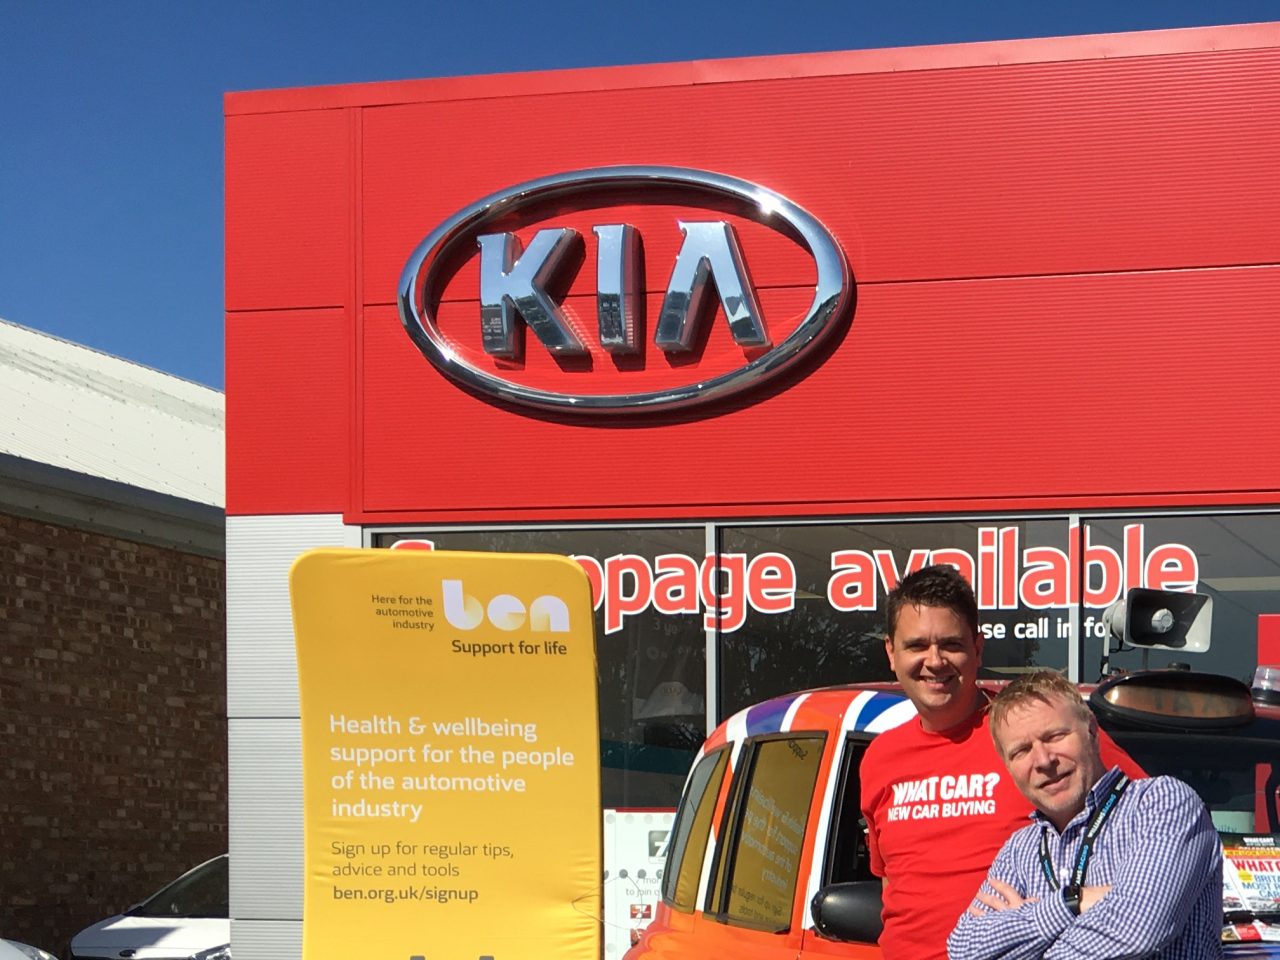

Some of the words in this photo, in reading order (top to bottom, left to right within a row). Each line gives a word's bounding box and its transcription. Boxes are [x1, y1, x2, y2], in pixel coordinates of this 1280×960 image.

[476, 221, 773, 354] KIA
[371, 594, 397, 605] Here
[398, 594, 414, 605] for
[415, 595, 433, 605] the
[442, 579, 570, 632] ben
[375, 606, 434, 618] automotive
[392, 619, 435, 632] industry
[1014, 617, 1049, 639] call
[451, 640, 515, 657] Support
[519, 640, 540, 655] for
[544, 641, 568, 655] life
[329, 715, 401, 735] Health
[408, 716, 426, 735] &
[432, 718, 537, 742] wellbeing
[330, 746, 416, 767] support
[422, 744, 453, 763] for
[459, 746, 495, 764] the
[502, 747, 575, 770] people
[331, 771, 354, 790] of
[359, 772, 395, 790] the
[402, 773, 526, 792] automotive
[892, 776, 939, 806] WHAT
[940, 772, 1000, 801] CAR?
[332, 798, 423, 823] industry
[888, 805, 911, 822] NEW
[912, 803, 939, 819] CAR
[942, 800, 996, 818] BUYING
[331, 841, 366, 859] Sign
[371, 844, 391, 859] up
[396, 841, 418, 855] for
[423, 842, 478, 859] regular
[482, 843, 514, 859] tips,
[332, 863, 382, 877] advice
[387, 863, 417, 877] and
[421, 863, 460, 877] tools
[1231, 859, 1274, 872] WHAT
[333, 885, 479, 904] ben.org.uk/signup
